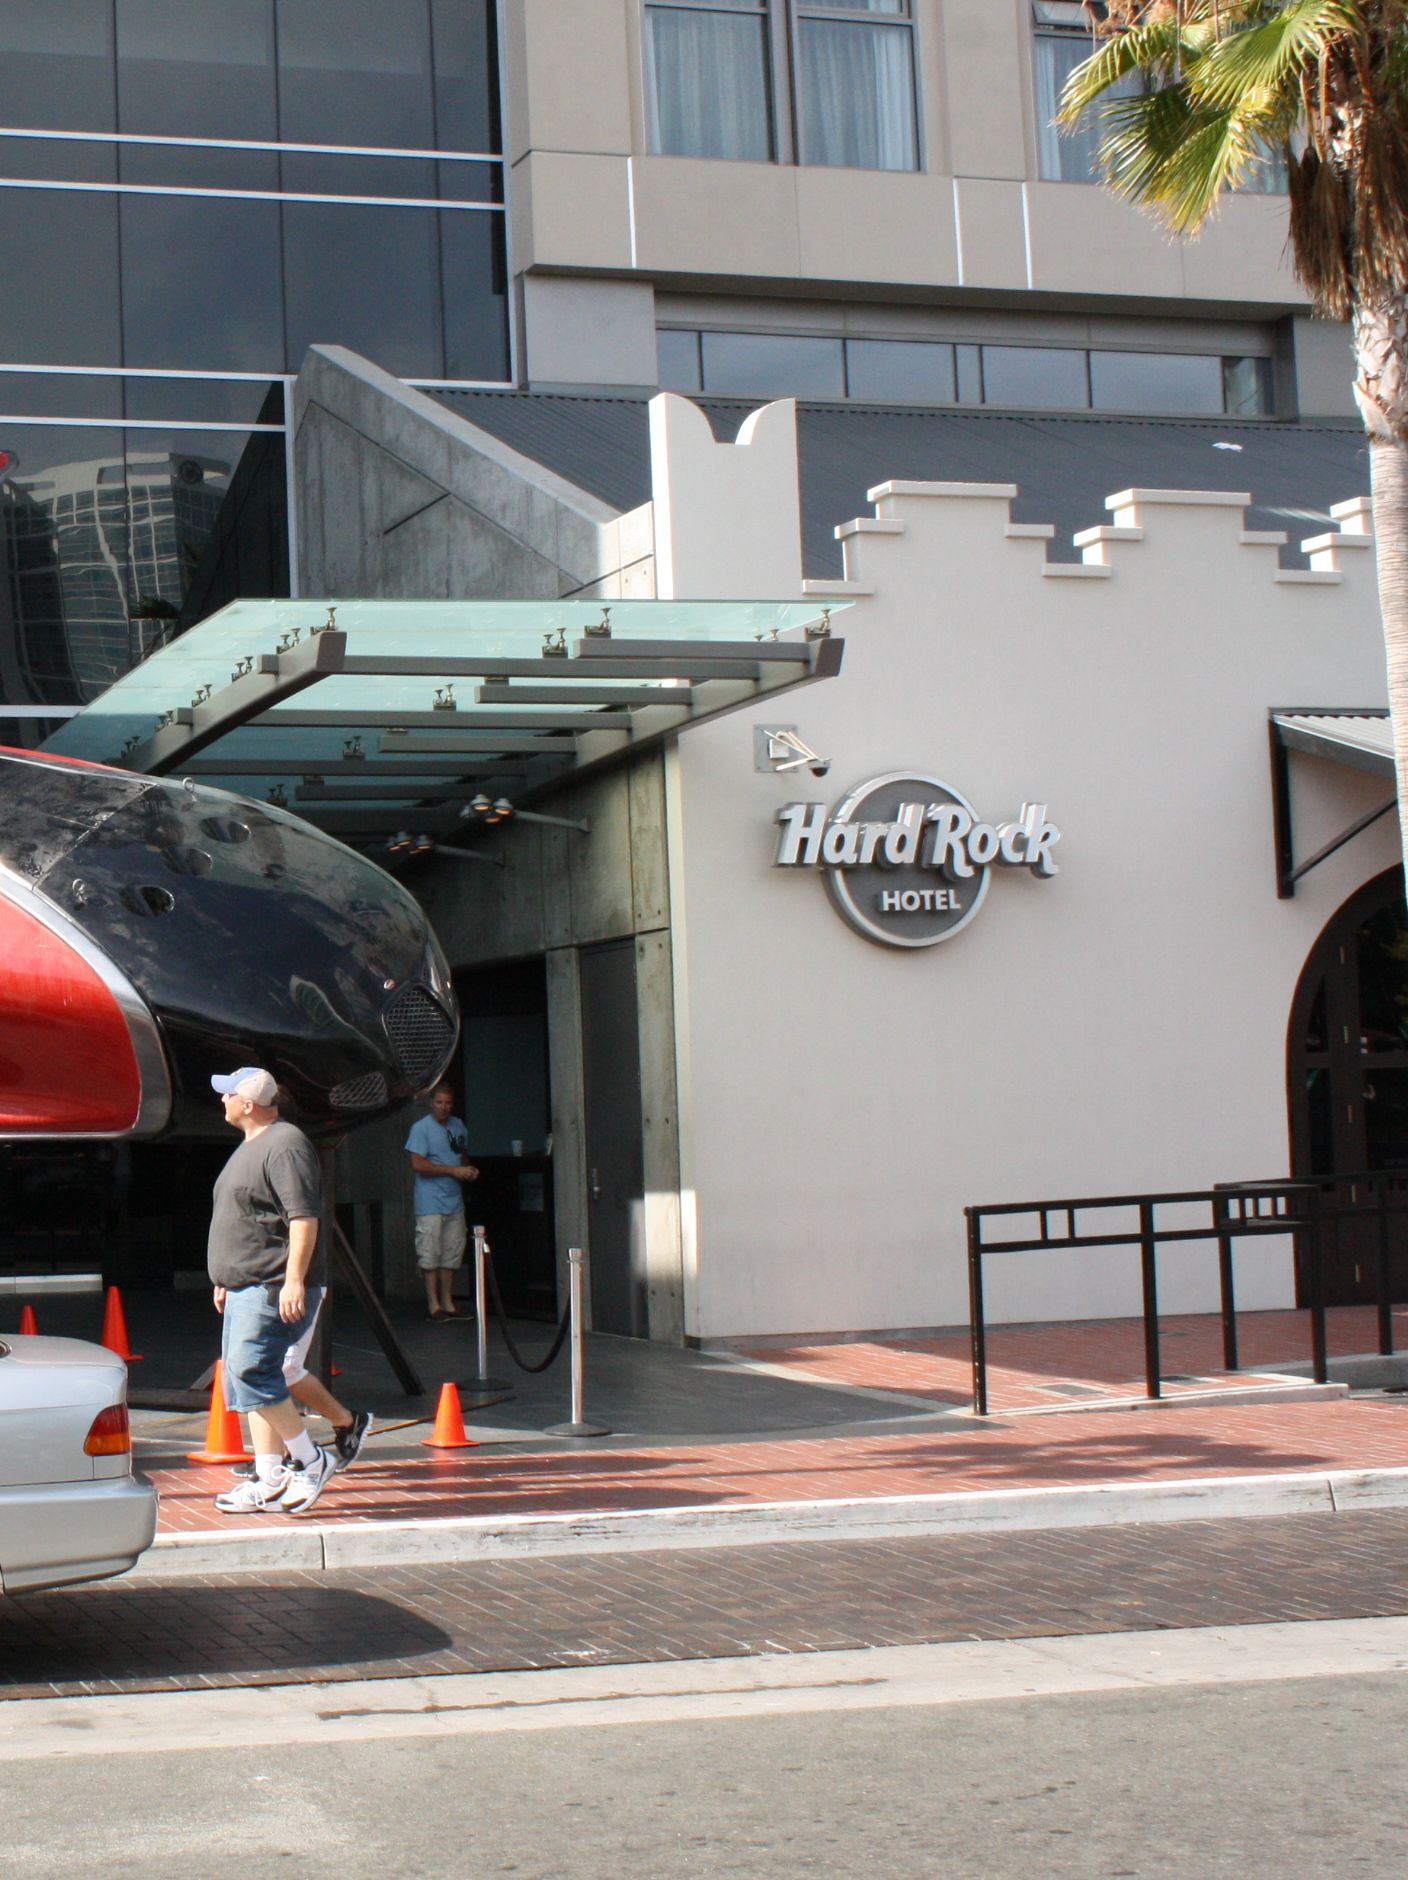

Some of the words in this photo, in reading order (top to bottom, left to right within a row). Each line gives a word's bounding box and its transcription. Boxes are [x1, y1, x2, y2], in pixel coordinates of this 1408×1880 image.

[775, 802, 925, 866] Hard
[925, 802, 1061, 878] Rock
[882, 889, 962, 911] HOTEL
